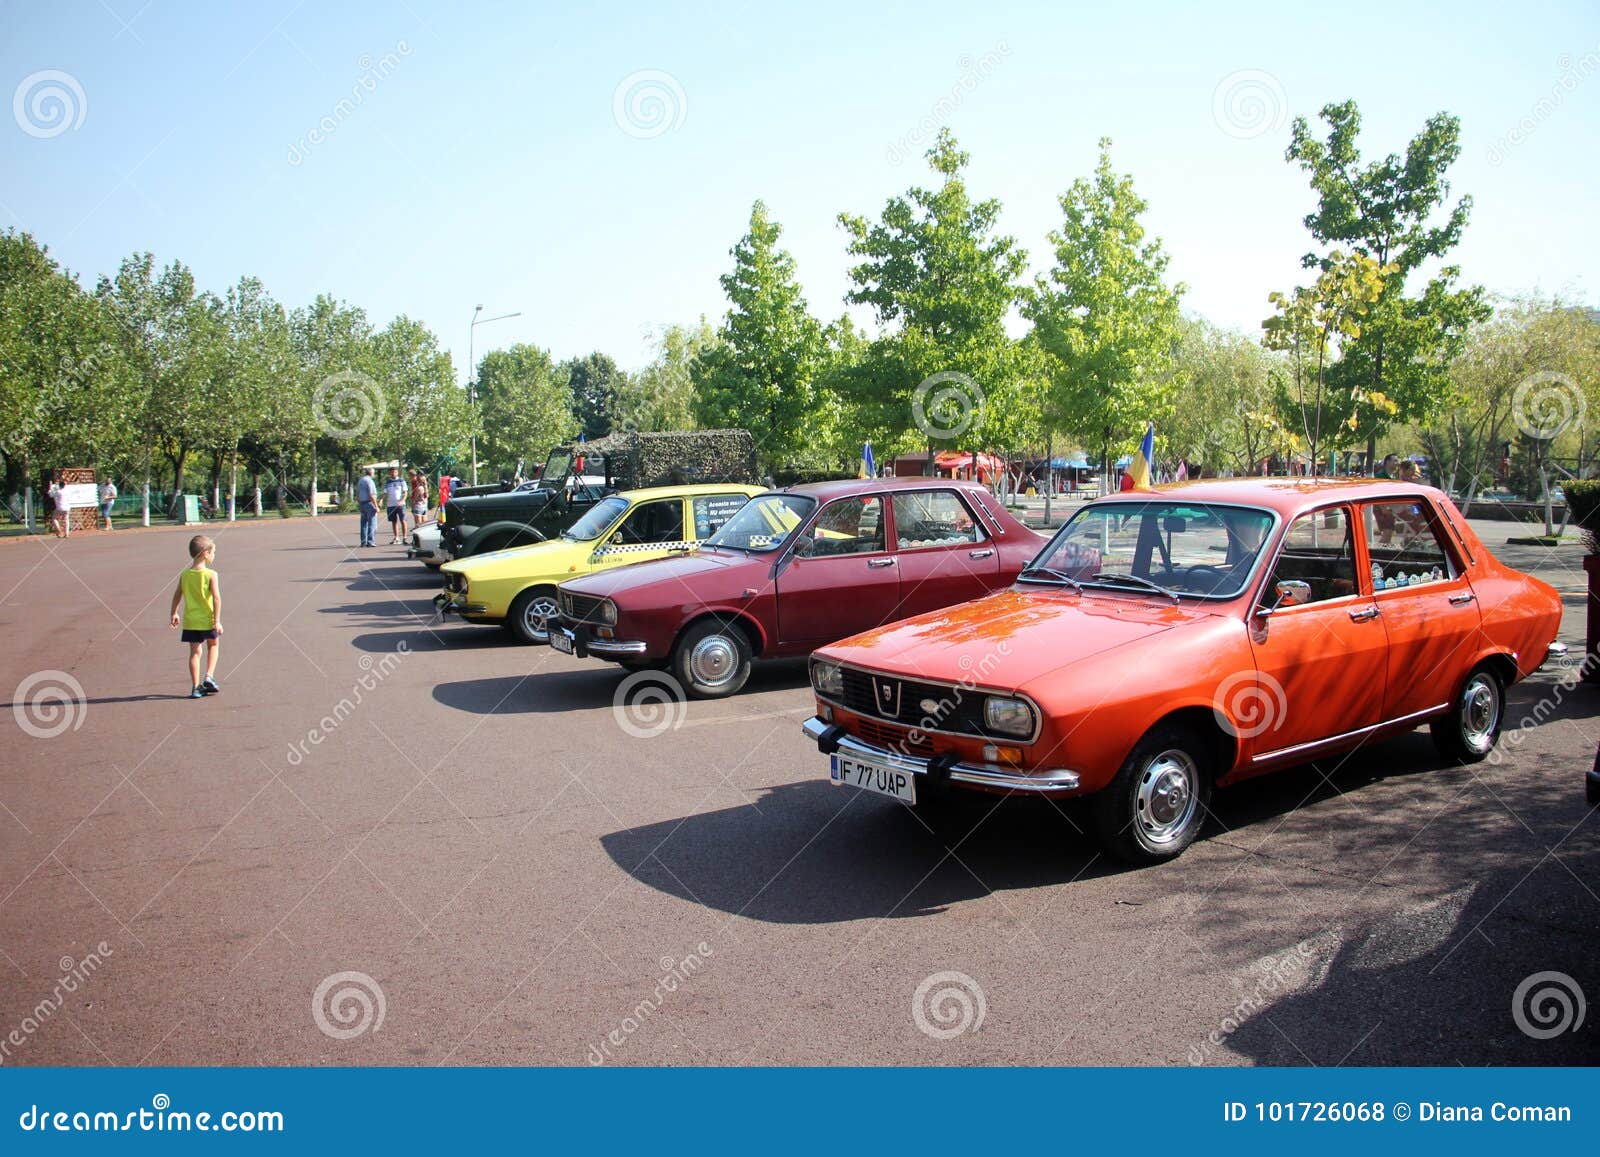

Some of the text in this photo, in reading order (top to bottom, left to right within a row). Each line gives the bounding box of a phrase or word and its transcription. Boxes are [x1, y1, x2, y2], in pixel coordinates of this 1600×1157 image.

[840, 760, 907, 796] IF 77 UAP
